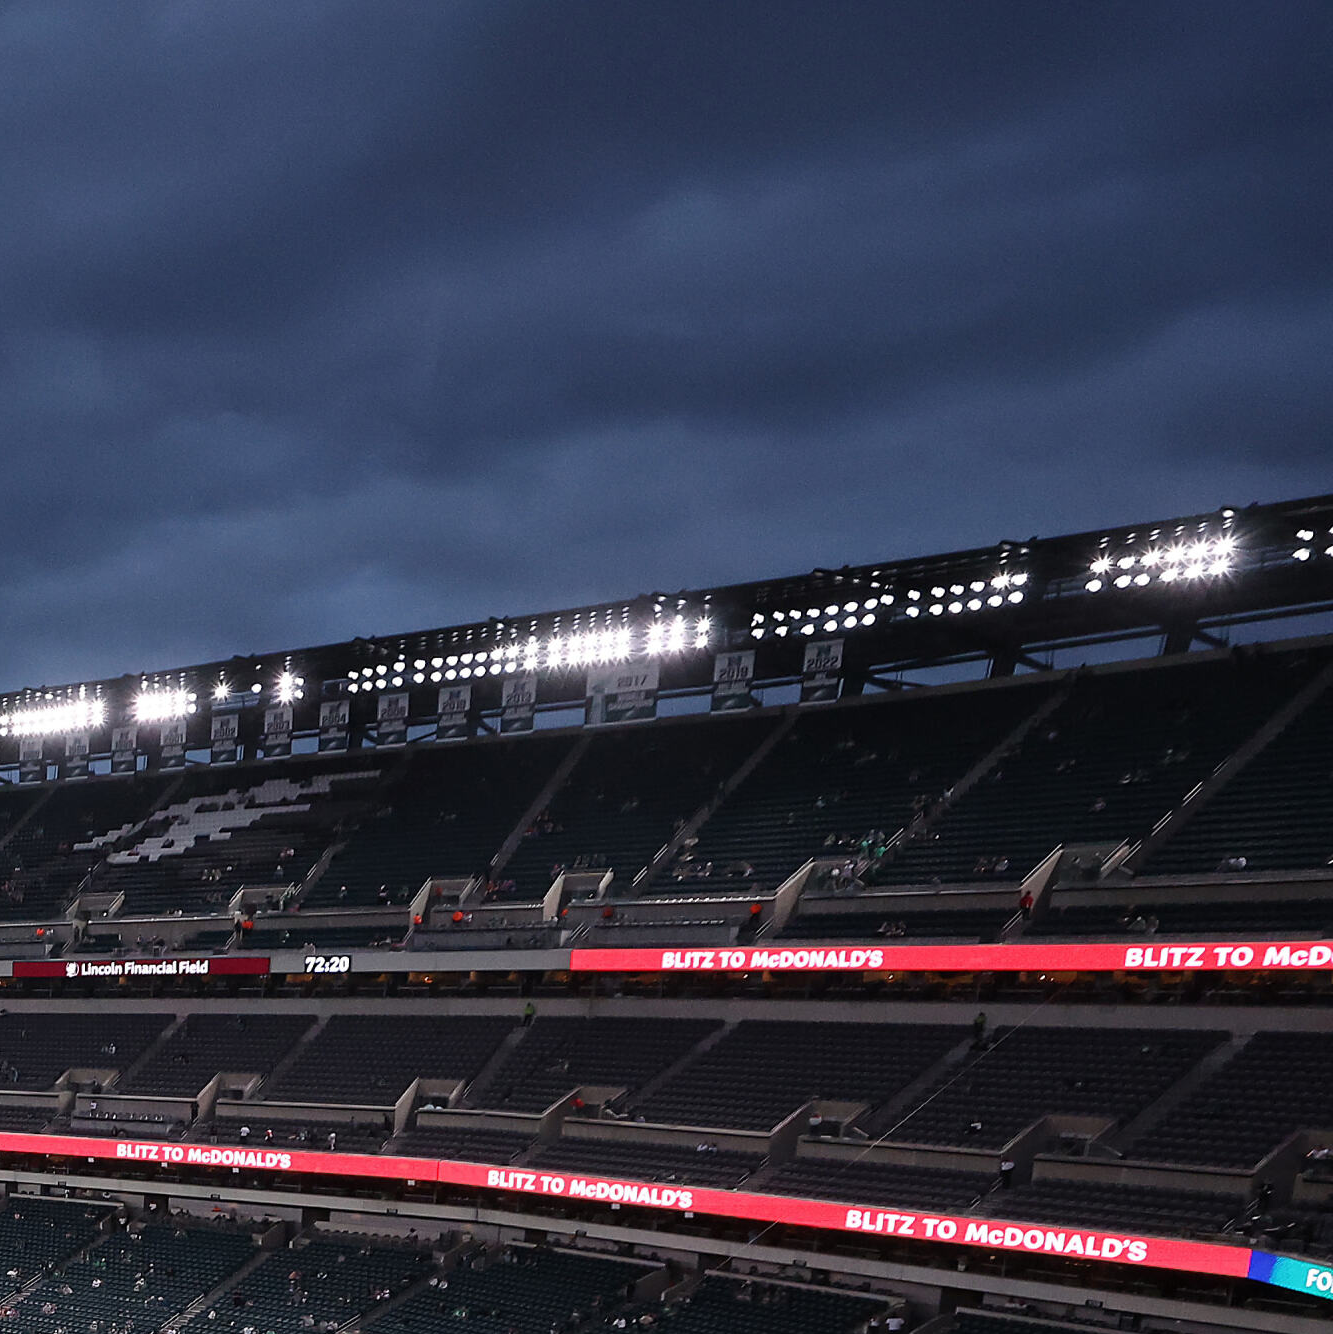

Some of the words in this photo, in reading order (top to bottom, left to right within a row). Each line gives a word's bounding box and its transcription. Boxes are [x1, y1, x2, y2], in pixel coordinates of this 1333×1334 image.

[80, 961, 121, 976] Lincoln
[124, 960, 176, 975] Financial
[179, 959, 209, 974] Field
[304, 956, 351, 973] 72:20
[661, 951, 715, 969] BLITZ
[718, 951, 746, 968] TO
[750, 949, 884, 969] McDONALD'S
[1124, 946, 1205, 968] BLITZ
[1212, 946, 1254, 967] TO
[1262, 946, 1333, 967] McD
[116, 1143, 159, 1159] BLITZ
[162, 1145, 185, 1161] TO
[187, 1147, 292, 1169] McDONALD'S
[487, 1169, 536, 1191] BLITZ
[539, 1174, 565, 1194] TO
[569, 1179, 693, 1209] McDONALD'S
[845, 1209, 916, 1236] BLITZ
[922, 1216, 958, 1240] TO
[964, 1224, 1148, 1262] McDONALD'S
[1306, 1268, 1333, 1292] FO
